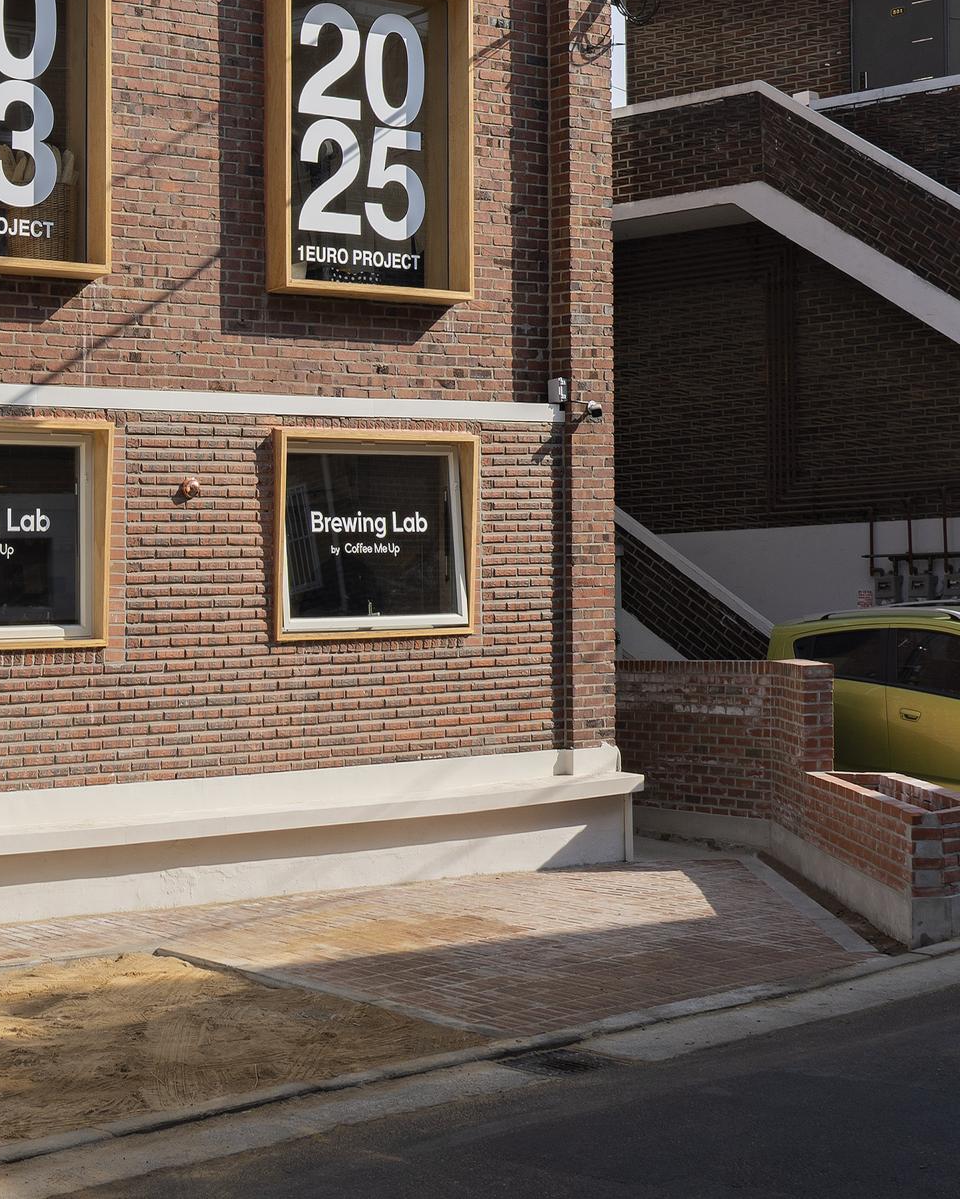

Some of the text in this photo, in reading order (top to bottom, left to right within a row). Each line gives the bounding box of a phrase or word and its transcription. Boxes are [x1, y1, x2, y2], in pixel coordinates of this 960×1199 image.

[298, 3, 425, 127] 20
[298, 118, 426, 241] 25
[297, 245, 421, 270] 1EURO PROJECT
[7, 508, 51, 532] Lab
[310, 510, 428, 538] Brewing Lab
[0, 544, 15, 559] Up
[330, 542, 401, 557] by Coffee Me Up
